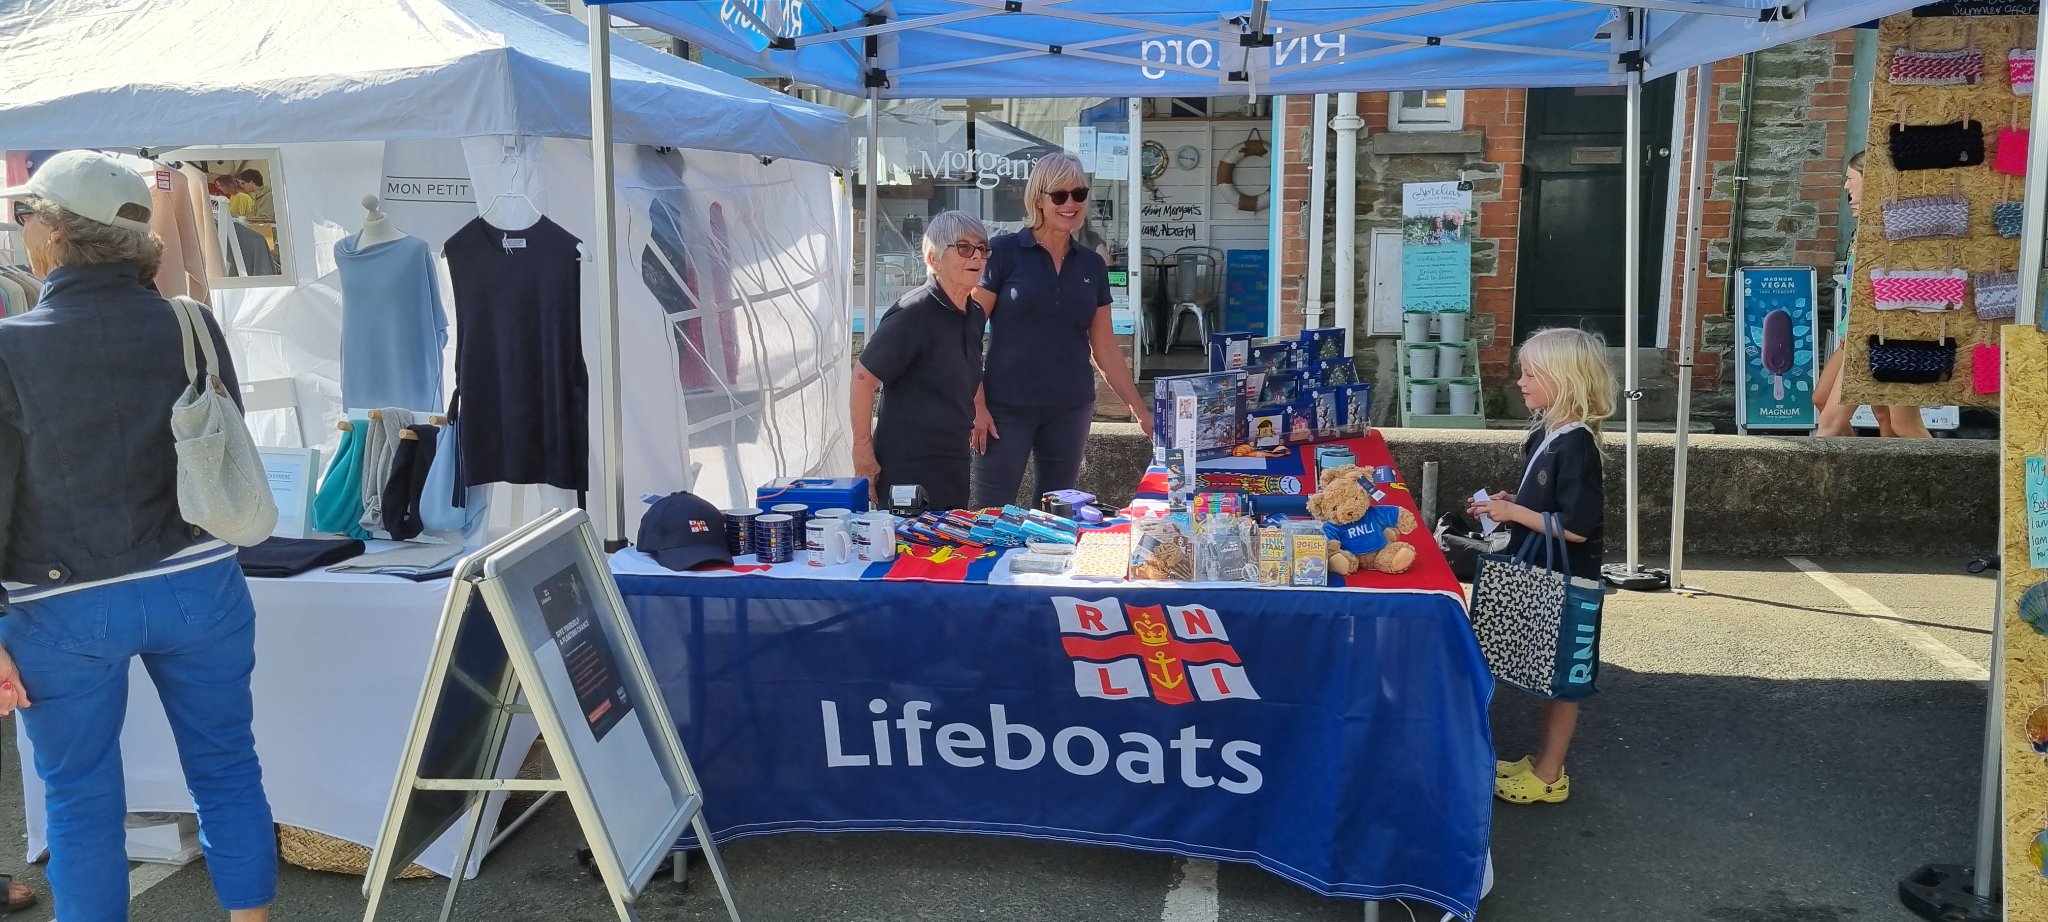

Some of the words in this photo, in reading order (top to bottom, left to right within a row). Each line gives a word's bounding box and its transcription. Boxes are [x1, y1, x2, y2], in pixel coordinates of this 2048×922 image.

[1952, 3, 2001, 16] Summer
[919, 149, 1038, 190] Morgan's
[387, 182, 421, 194] MON
[427, 184, 469, 196] PETIT
[1760, 281, 1795, 289] VEGAN
[2030, 460, 2046, 485] My
[1347, 523, 1374, 539] RNLI
[1260, 543, 1285, 551] STAMP
[576, 620, 590, 633] CHANCE
[1074, 602, 1110, 632] R
[1181, 608, 1214, 635] N
[1568, 601, 1600, 684] RNLI
[1096, 667, 1130, 696] L
[1210, 666, 1233, 696] I
[820, 698, 1264, 795] Lifeboats
